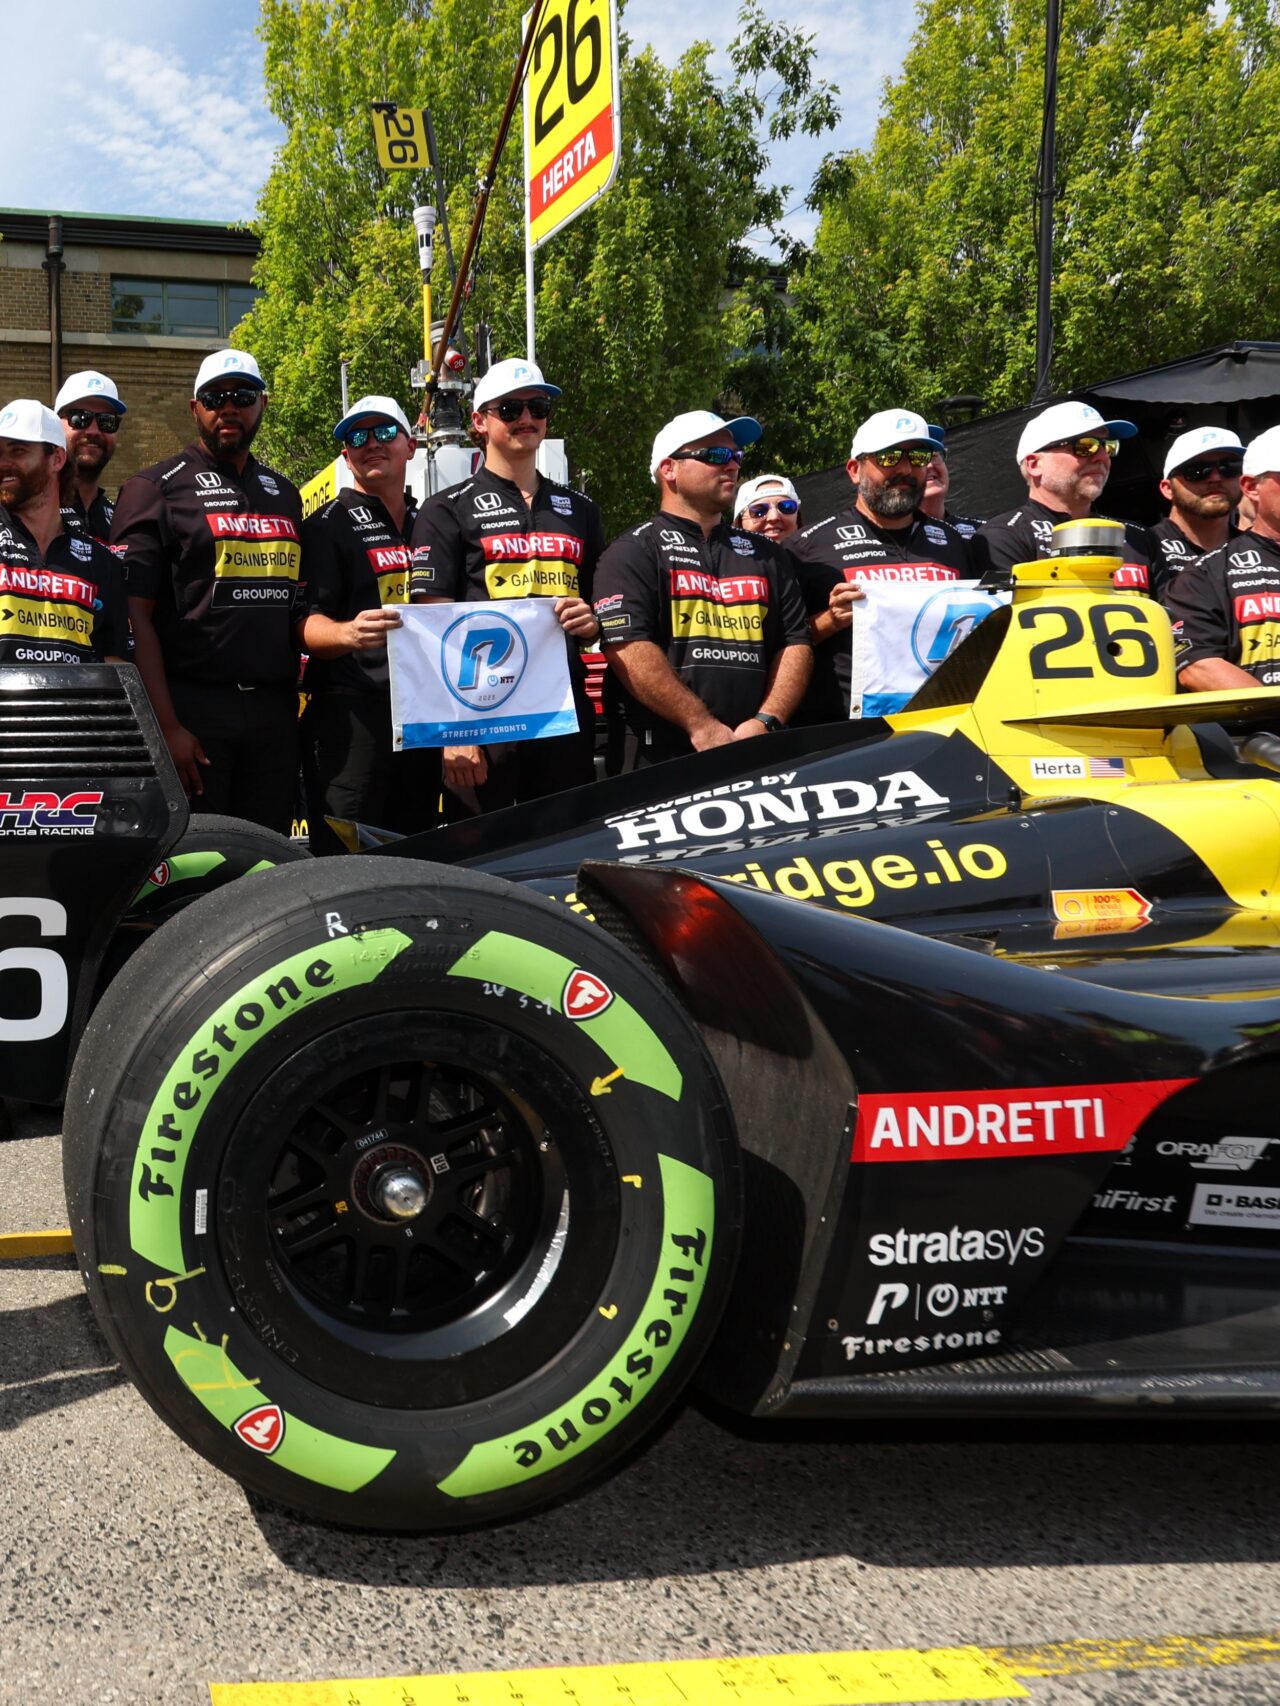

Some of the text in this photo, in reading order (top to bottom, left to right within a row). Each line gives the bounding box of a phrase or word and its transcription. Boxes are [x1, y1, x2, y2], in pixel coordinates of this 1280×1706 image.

[534, 0, 602, 147] 26
[542, 130, 597, 204] HERTA
[195, 488, 235, 497] HONDA
[472, 507, 517, 518] HONDA
[217, 516, 296, 536] ANDRETTI
[492, 536, 581, 558] ANDRETTI
[833, 539, 882, 550] HONDA
[0, 568, 93, 602] ANDRETTI
[854, 567, 957, 582] ANDRETTI
[18, 609, 89, 633] GAINBRIDGE
[1018, 604, 1159, 679] 26
[692, 648, 760, 663] GROUP1001
[500, 675, 515, 684] NTT
[442, 723, 527, 739] STREETS OF TORONTO
[1035, 762, 1082, 775] Herta
[604, 771, 797, 824] POWERED by
[605, 770, 950, 850] HONDA
[40, 828, 95, 836] RACING
[1093, 895, 1121, 904] 100%
[325, 912, 348, 938] R
[138, 958, 335, 1203] Firestone
[870, 1098, 1105, 1148] ANDRETTI
[1156, 1141, 1265, 1160] ORAFOL
[868, 1225, 1045, 1267] stratasys
[962, 1285, 1007, 1308] NTT
[513, 1228, 707, 1468] Firestone
[842, 1329, 1002, 1361] Firestone
